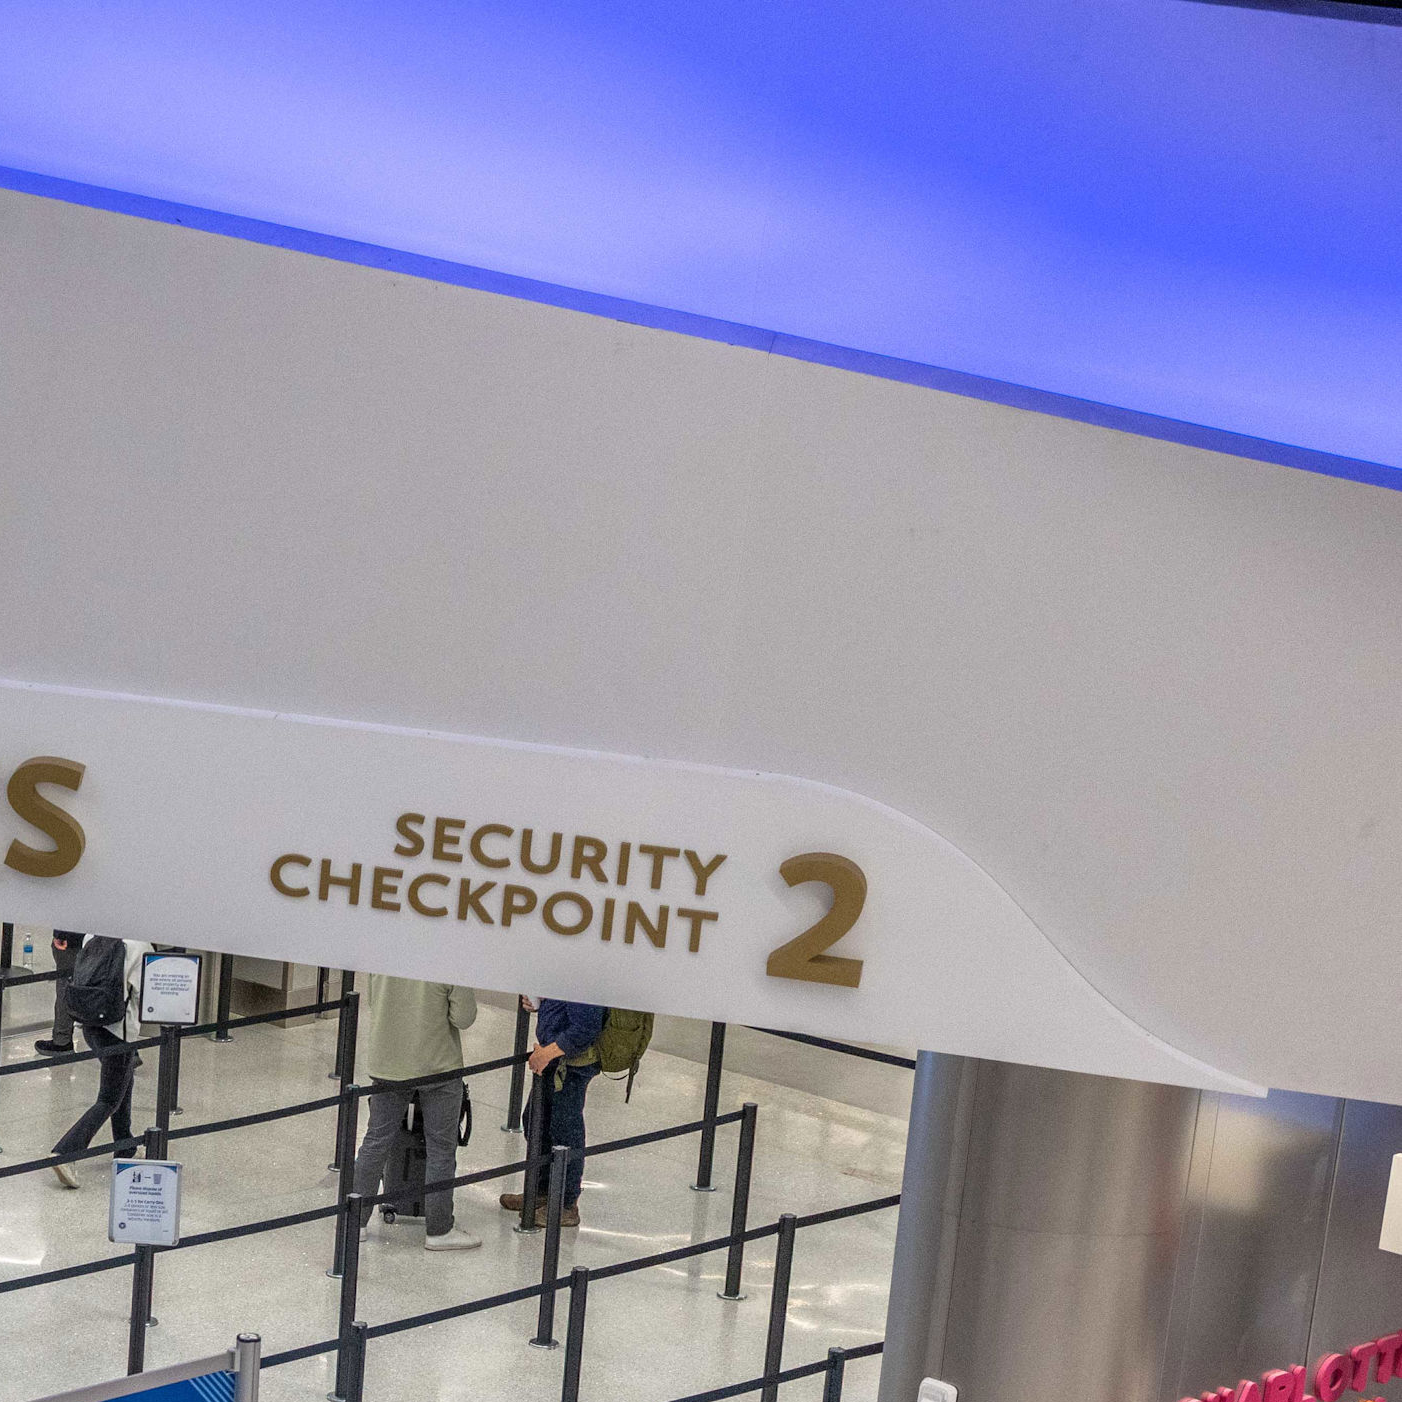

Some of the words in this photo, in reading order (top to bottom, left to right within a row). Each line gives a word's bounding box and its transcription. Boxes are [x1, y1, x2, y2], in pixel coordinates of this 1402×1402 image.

[394, 812, 728, 896] SECURITY
[269, 853, 719, 953] CHECKPOINT
[766, 851, 869, 989] 2
